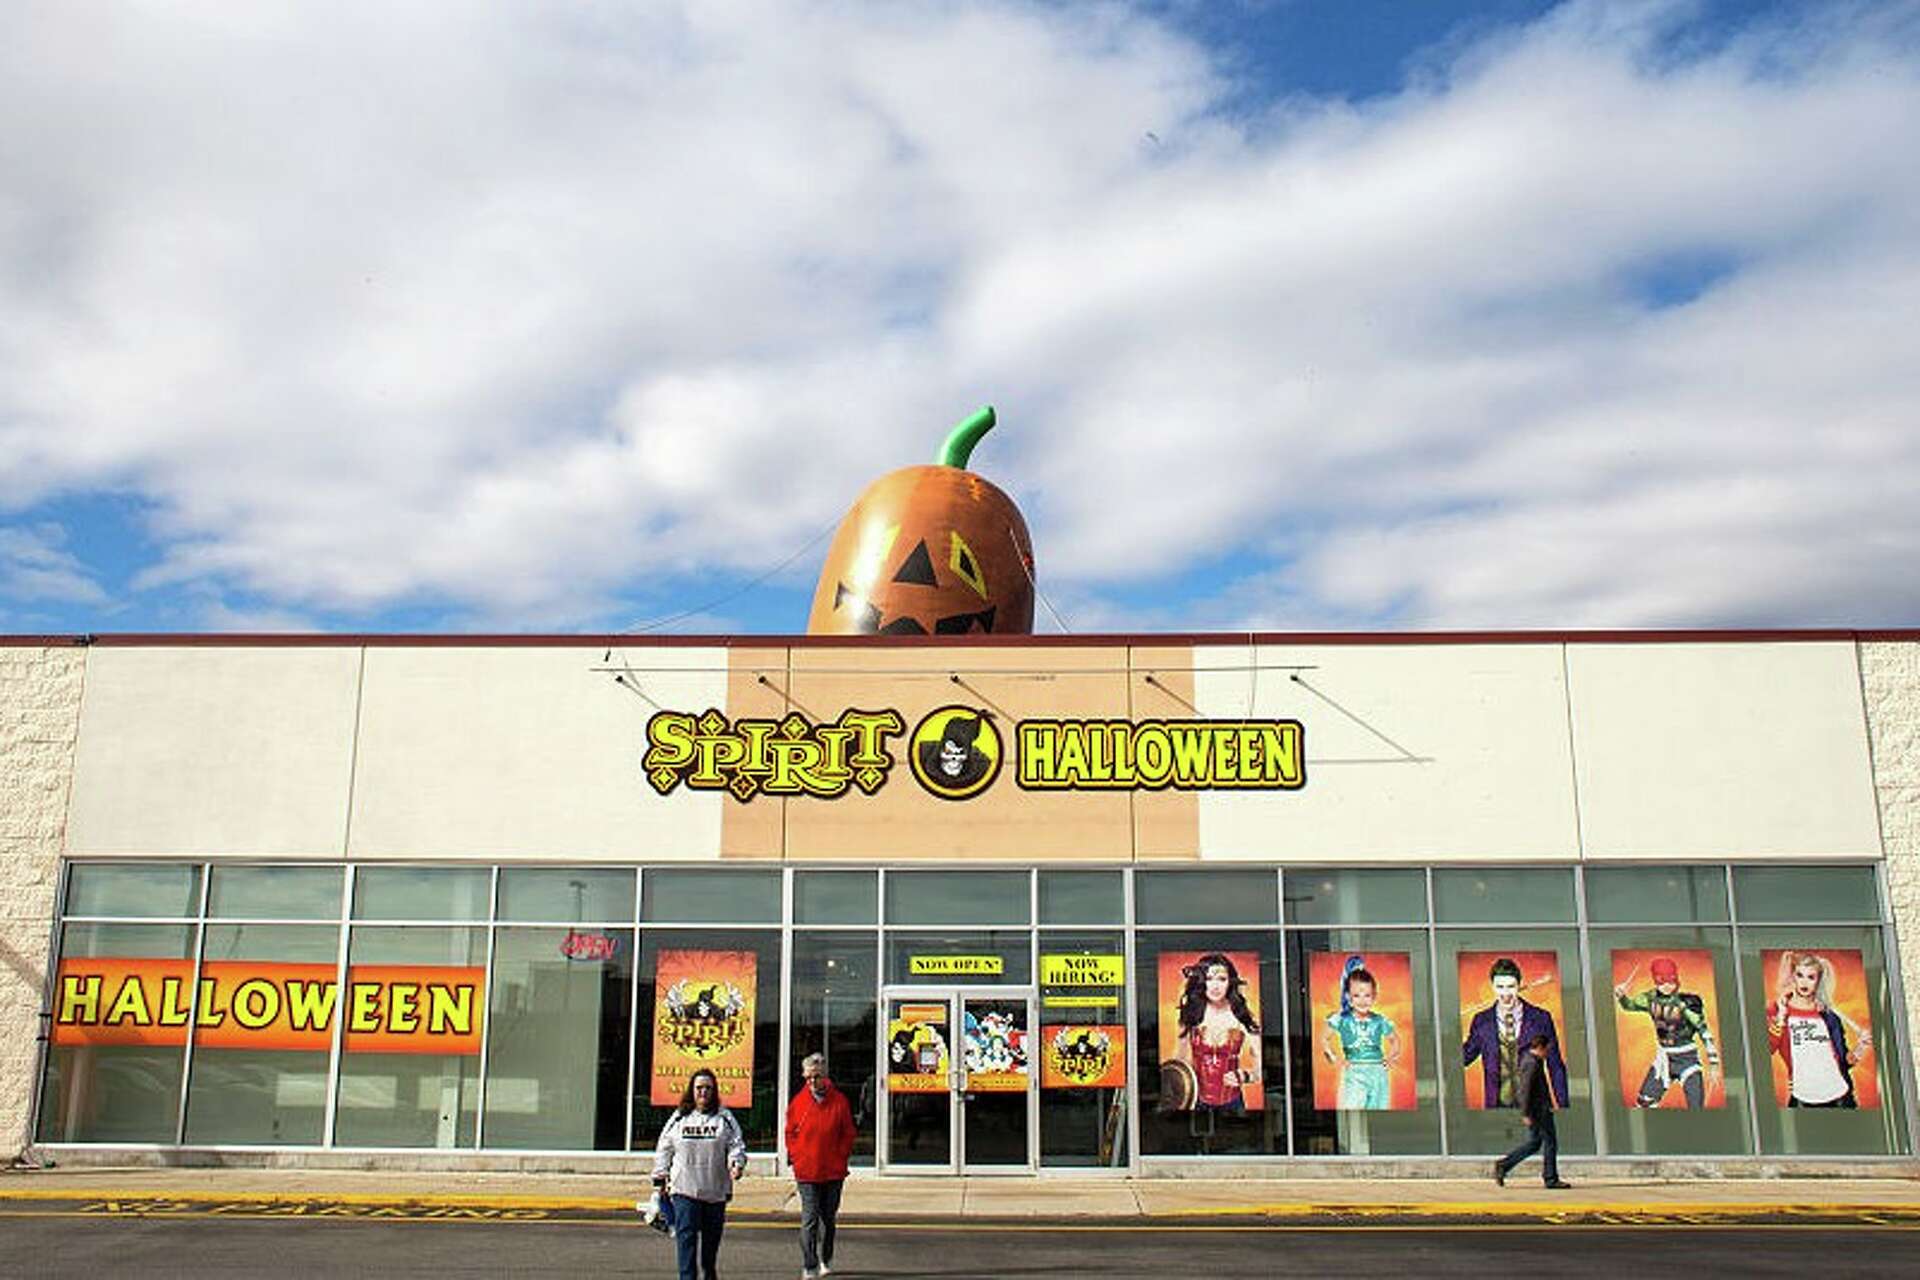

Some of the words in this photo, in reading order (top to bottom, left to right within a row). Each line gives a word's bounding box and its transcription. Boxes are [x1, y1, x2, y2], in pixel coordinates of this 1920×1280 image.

[644, 711, 903, 797] SPIRIT
[1019, 723, 1303, 787] HALLOWEEN
[915, 959, 948, 970] NOW
[1064, 958, 1098, 969] NOW
[1048, 971, 1116, 984] HIRING!
[57, 975, 474, 1035] HALLOWEEN
[657, 1015, 749, 1046] SPIRIT
[1050, 1053, 1112, 1074] SPIRIT
